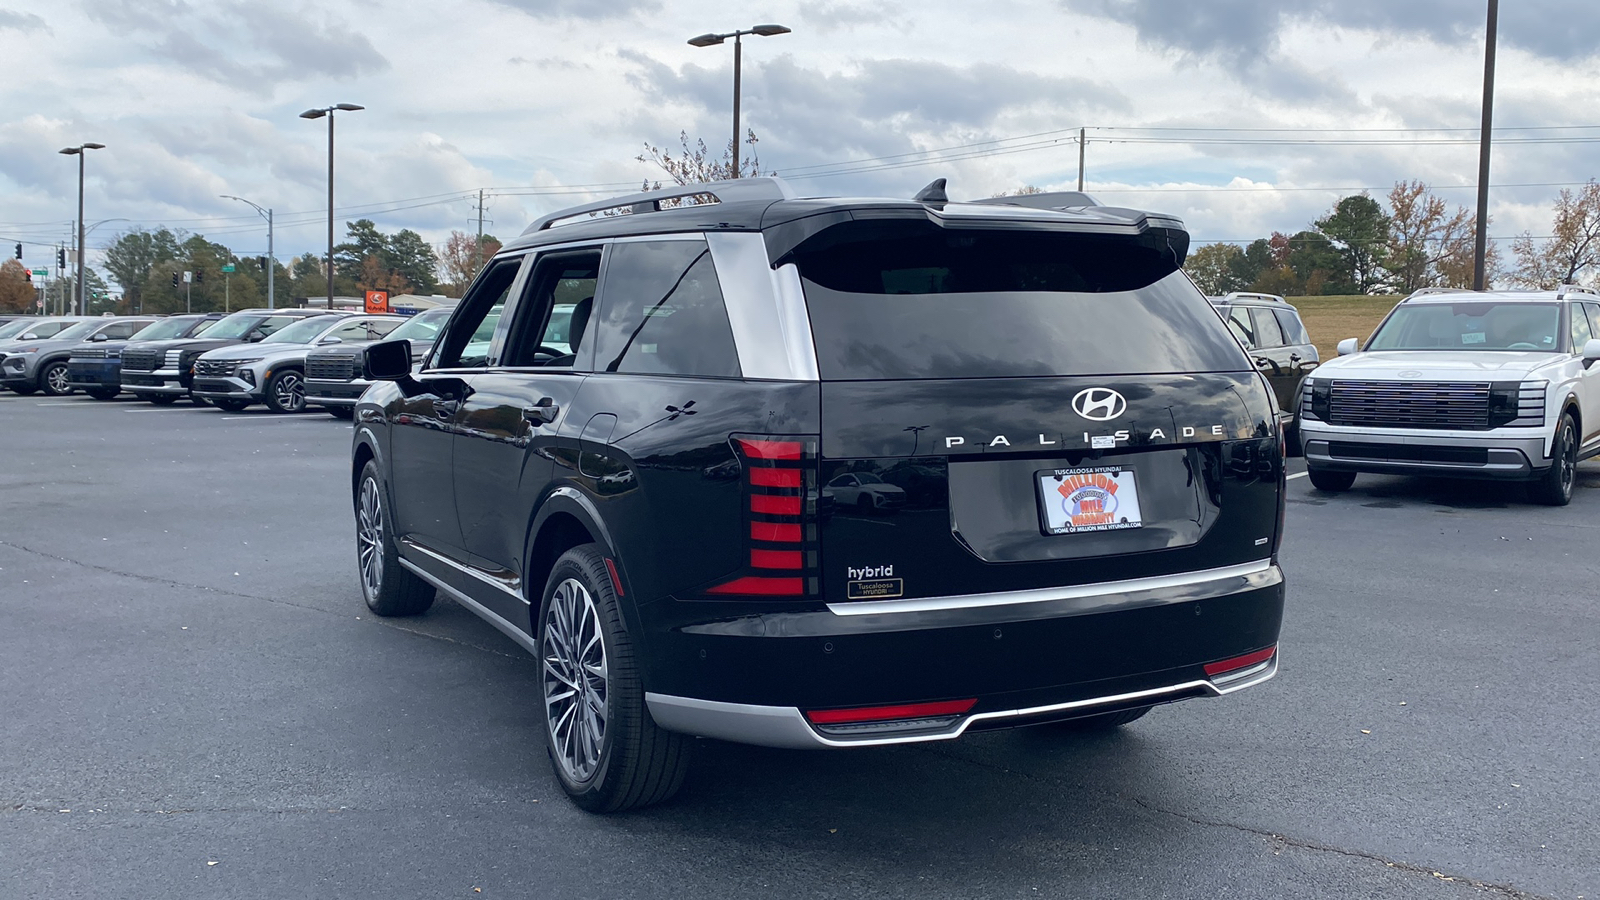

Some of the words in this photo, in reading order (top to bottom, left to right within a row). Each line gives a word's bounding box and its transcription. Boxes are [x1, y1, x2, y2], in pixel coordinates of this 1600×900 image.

[945, 425, 1223, 448] PALISADE
[1054, 467, 1093, 475] TUSCALOOSA
[1057, 473, 1119, 499] MILLION
[1080, 499, 1104, 514] MILE
[1071, 512, 1115, 526] WARRANTY
[848, 564, 893, 580] hybrid
[857, 582, 893, 590] Tuscaloosa
